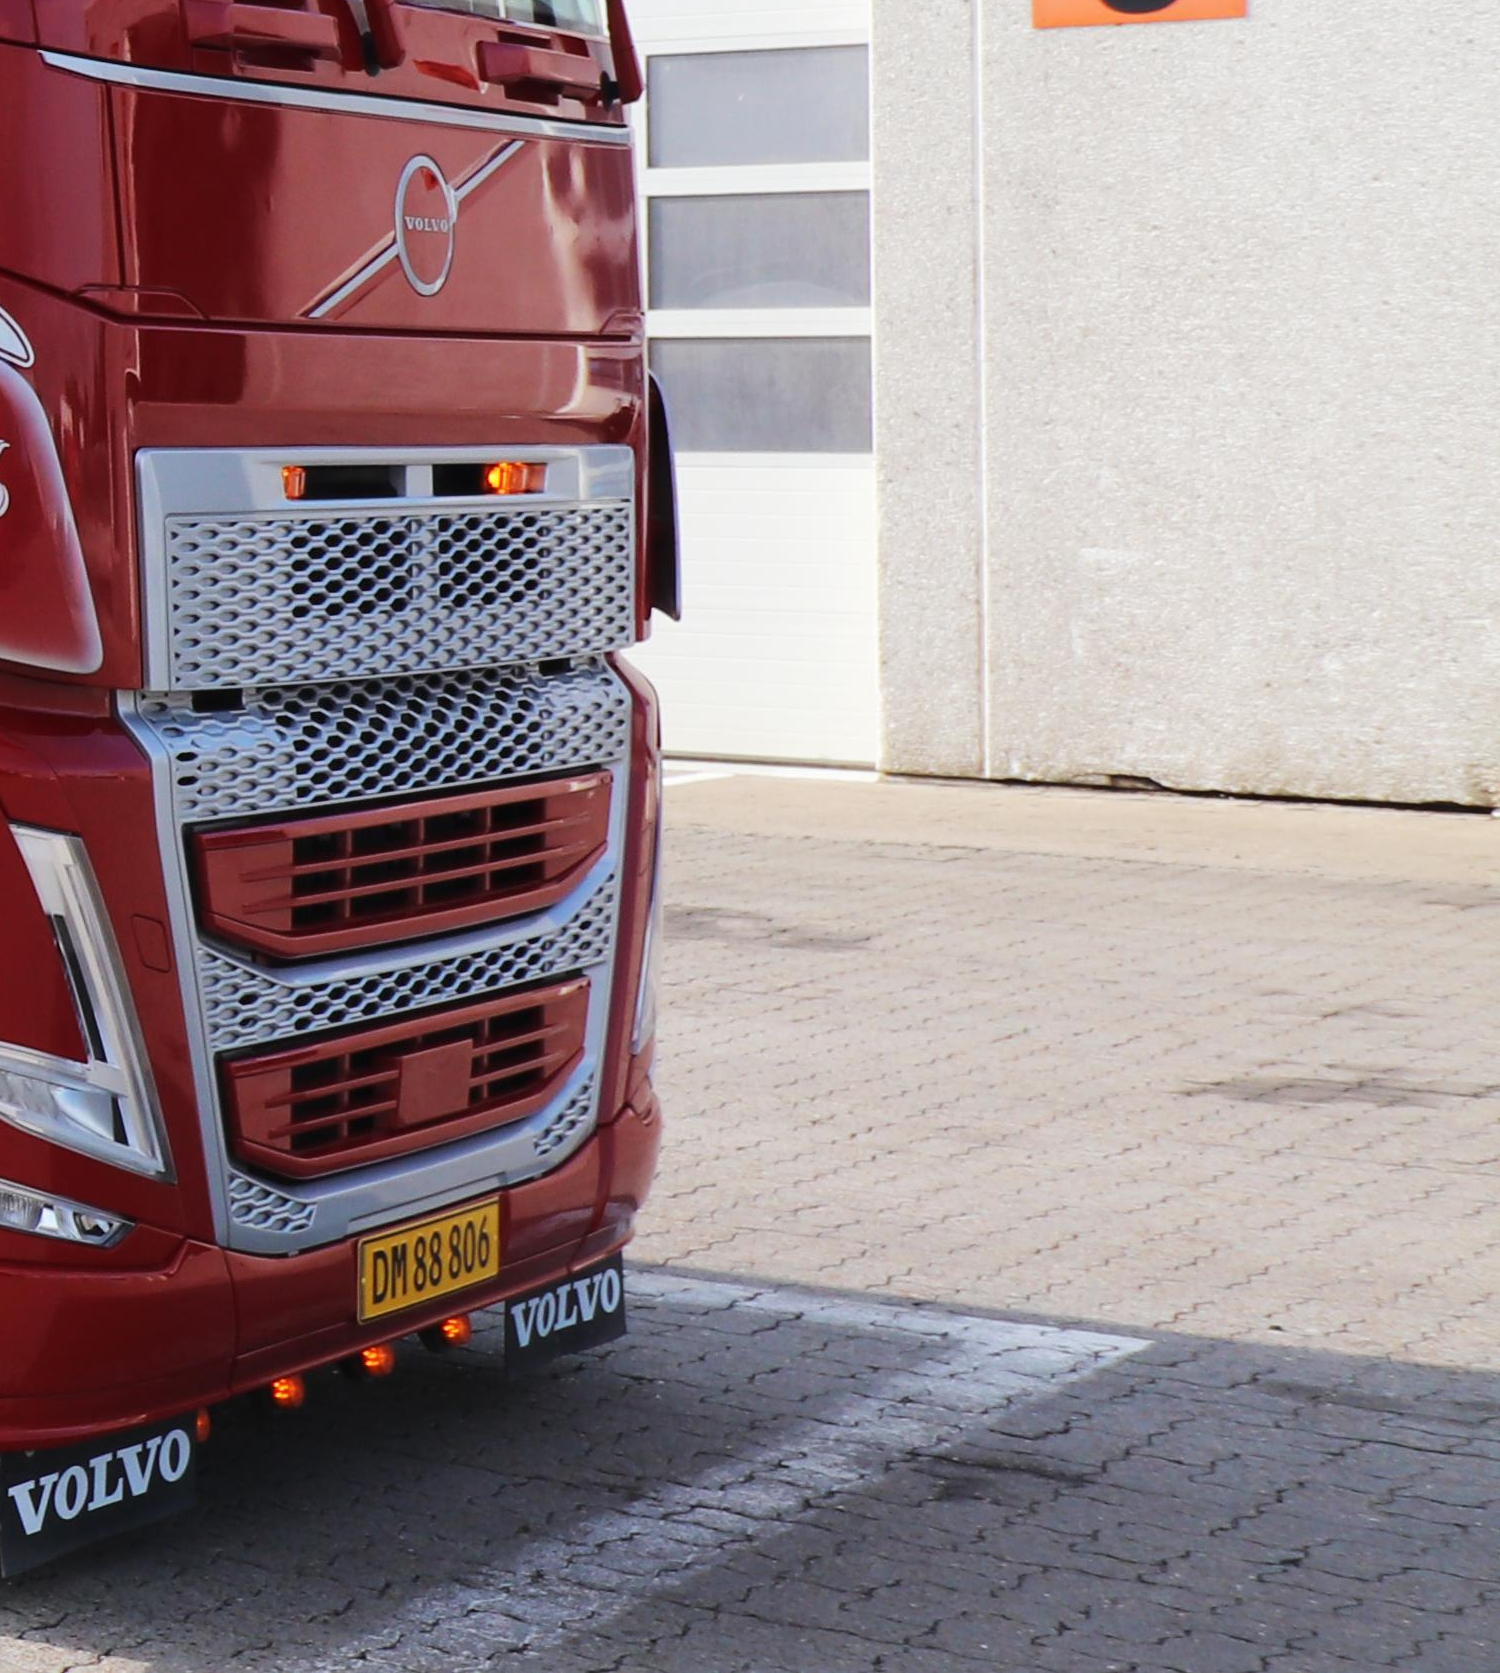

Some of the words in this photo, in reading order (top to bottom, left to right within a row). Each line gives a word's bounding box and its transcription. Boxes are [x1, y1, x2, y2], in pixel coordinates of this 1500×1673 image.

[404, 215, 449, 233] VOLVO
[372, 1242, 407, 1304] DM
[413, 1231, 443, 1292] 88
[449, 1215, 490, 1279] 806
[510, 1269, 621, 1347] VOLVO
[8, 1429, 191, 1535] VOLVO
